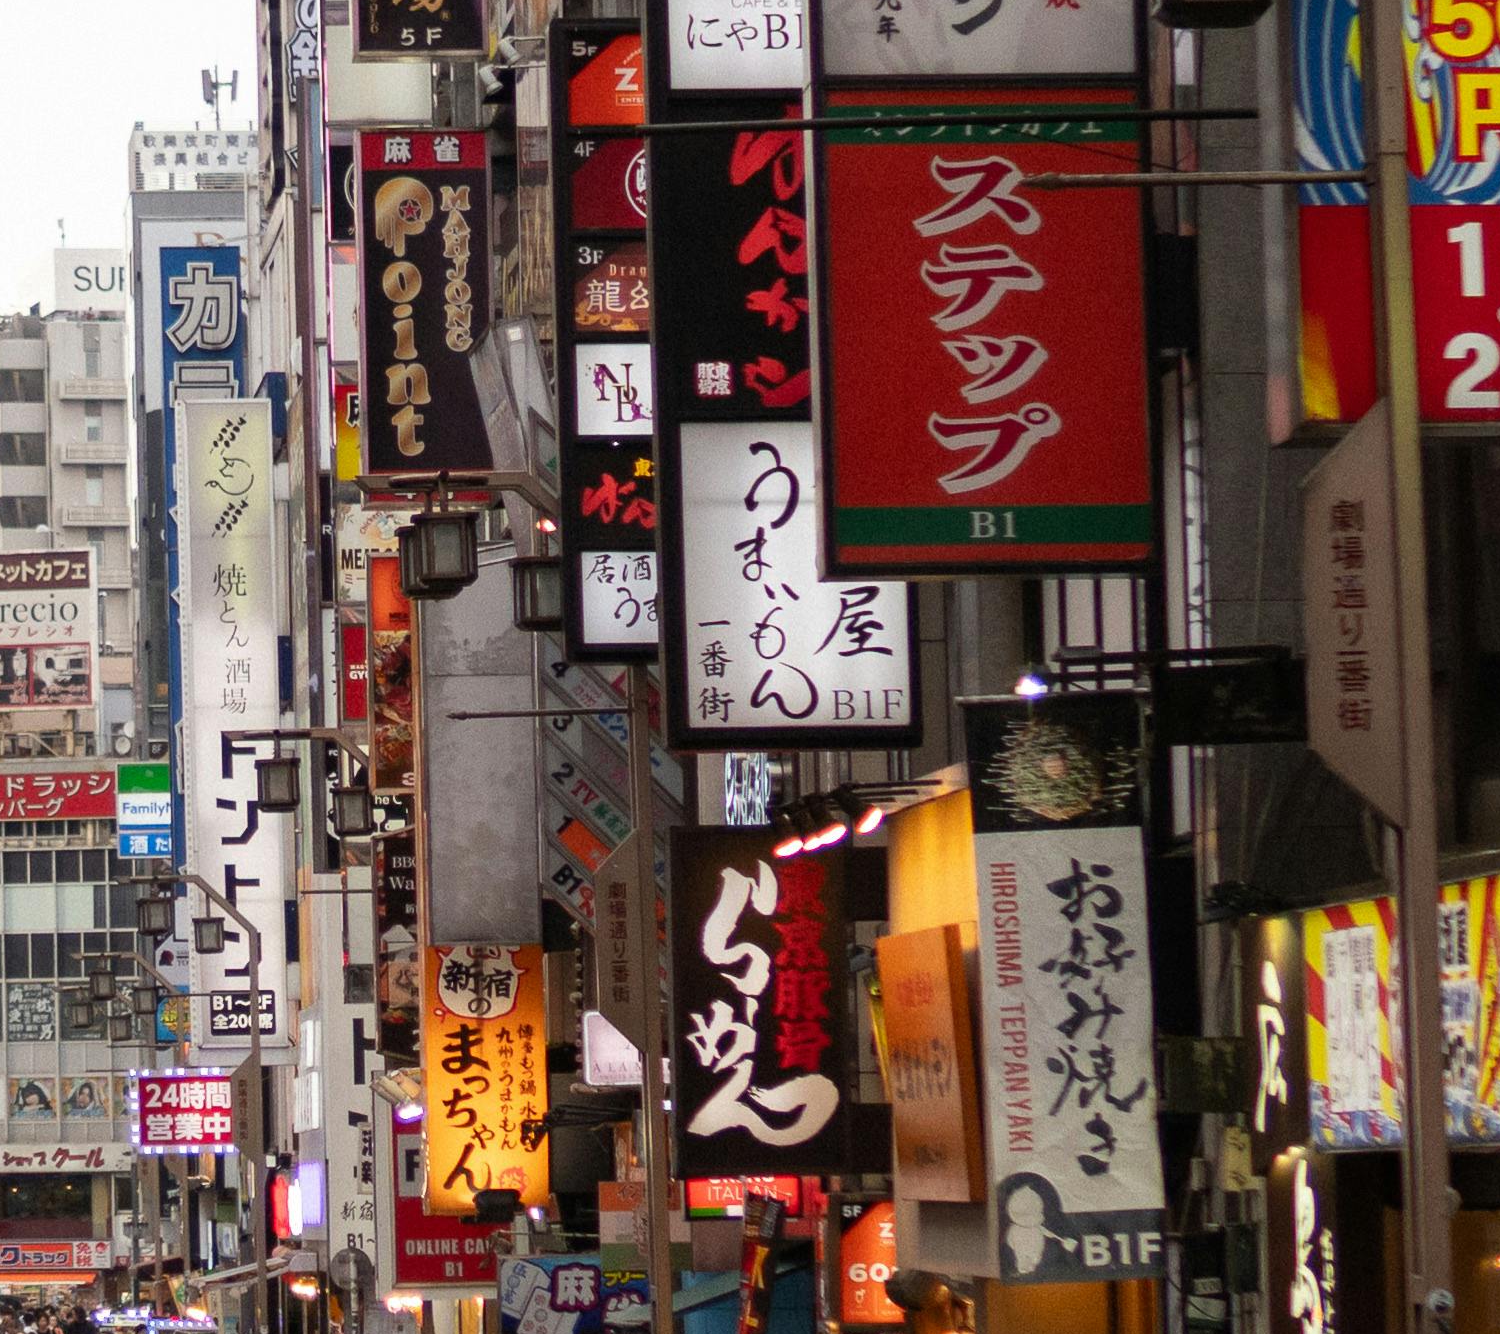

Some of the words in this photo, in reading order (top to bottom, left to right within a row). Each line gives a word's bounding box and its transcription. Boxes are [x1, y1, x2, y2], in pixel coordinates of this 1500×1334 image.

[400, 27, 442, 47] 5F
[572, 42, 597, 57] 5F
[384, 136, 460, 164] 麻雀
[573, 142, 595, 158] 4F
[440, 185, 473, 352] MAHJONG
[578, 247, 604, 264] 3F
[374, 175, 433, 457] Point
[914, 155, 1061, 495] ステップ
[970, 511, 1017, 539] B1
[736, 442, 819, 721] うまいもん
[1329, 497, 1373, 733] 劇場通り一番街
[212, 563, 251, 714] 焼とん酒場
[698, 620, 734, 721] 一番街
[832, 688, 905, 722] B1F
[130, 836, 148, 854] 酒
[990, 862, 1023, 987] HIROSHIMA
[608, 882, 631, 1003] 劇場通り一番街
[1038, 858, 1149, 1176] お好み焼き
[146, 1082, 231, 1109] 24時間
[441, 1023, 493, 1192] まっちゃん
[147, 1114, 231, 1140] 営業中
[52, 1147, 105, 1168] クール
[842, 1204, 862, 1218] 5F
[76, 1243, 94, 1267] 免税
[405, 1238, 447, 1256] ONLINE
[1084, 1232, 1163, 1268] B1F
[445, 1260, 463, 1277] B1
